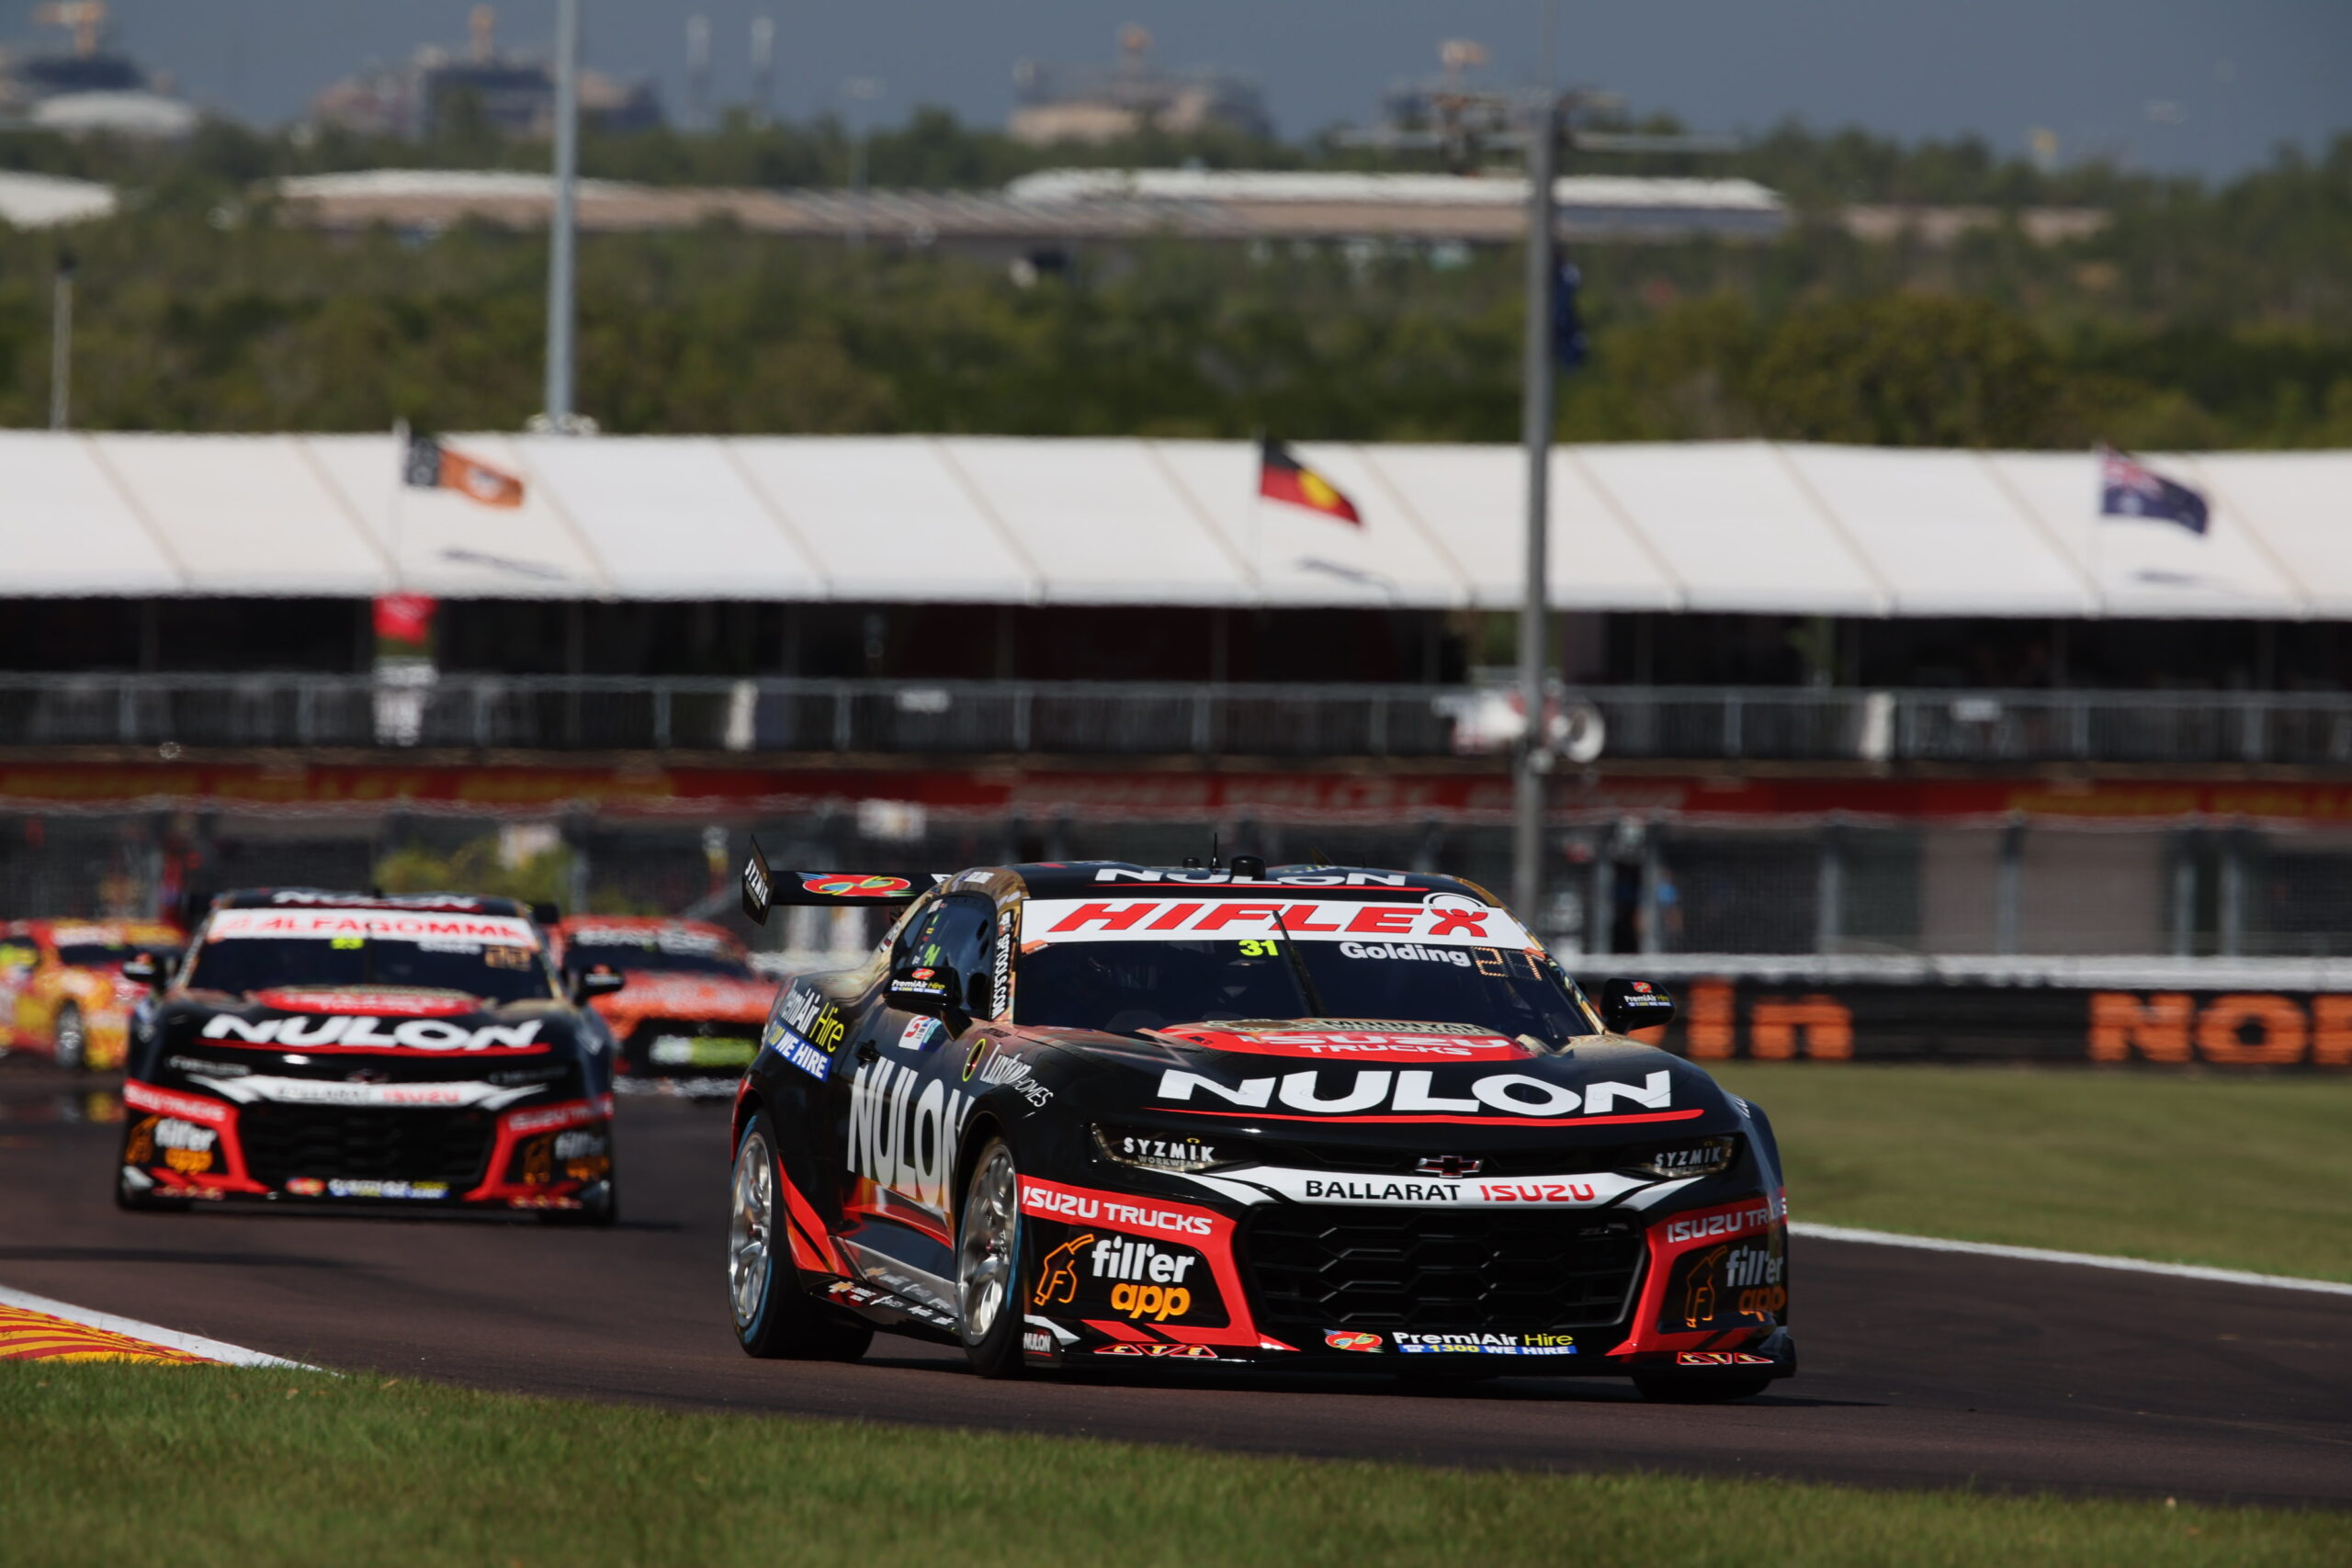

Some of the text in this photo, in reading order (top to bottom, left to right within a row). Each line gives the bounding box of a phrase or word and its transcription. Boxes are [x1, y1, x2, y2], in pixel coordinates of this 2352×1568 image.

[1094, 868, 1407, 886] NULON
[1047, 903, 1490, 939] HIFLEX
[1238, 939, 1280, 957] 31
[1339, 941, 1472, 968] Golding
[201, 1014, 545, 1051] NULON
[808, 1001, 844, 1053] Hire
[775, 1031, 799, 1058] WE
[791, 1043, 829, 1079] HIRE
[1299, 1044, 1473, 1056] TRUCKS
[1012, 1075, 1055, 1108] HOMES
[1158, 1068, 1672, 1116] NULON
[1123, 1136, 1215, 1163] SYZMIK
[1655, 1146, 1723, 1168] SYZMIK
[1306, 1180, 1597, 1202] BALLARAT ISUZU
[1023, 1186, 1213, 1235] ISUZU TRUCKS
[1667, 1212, 1743, 1244] ISUZU
[1111, 1282, 1191, 1322] app
[1393, 1332, 1575, 1347] PremiAir Hire
[1429, 1345, 1570, 1355] 1300 WE HIRE
